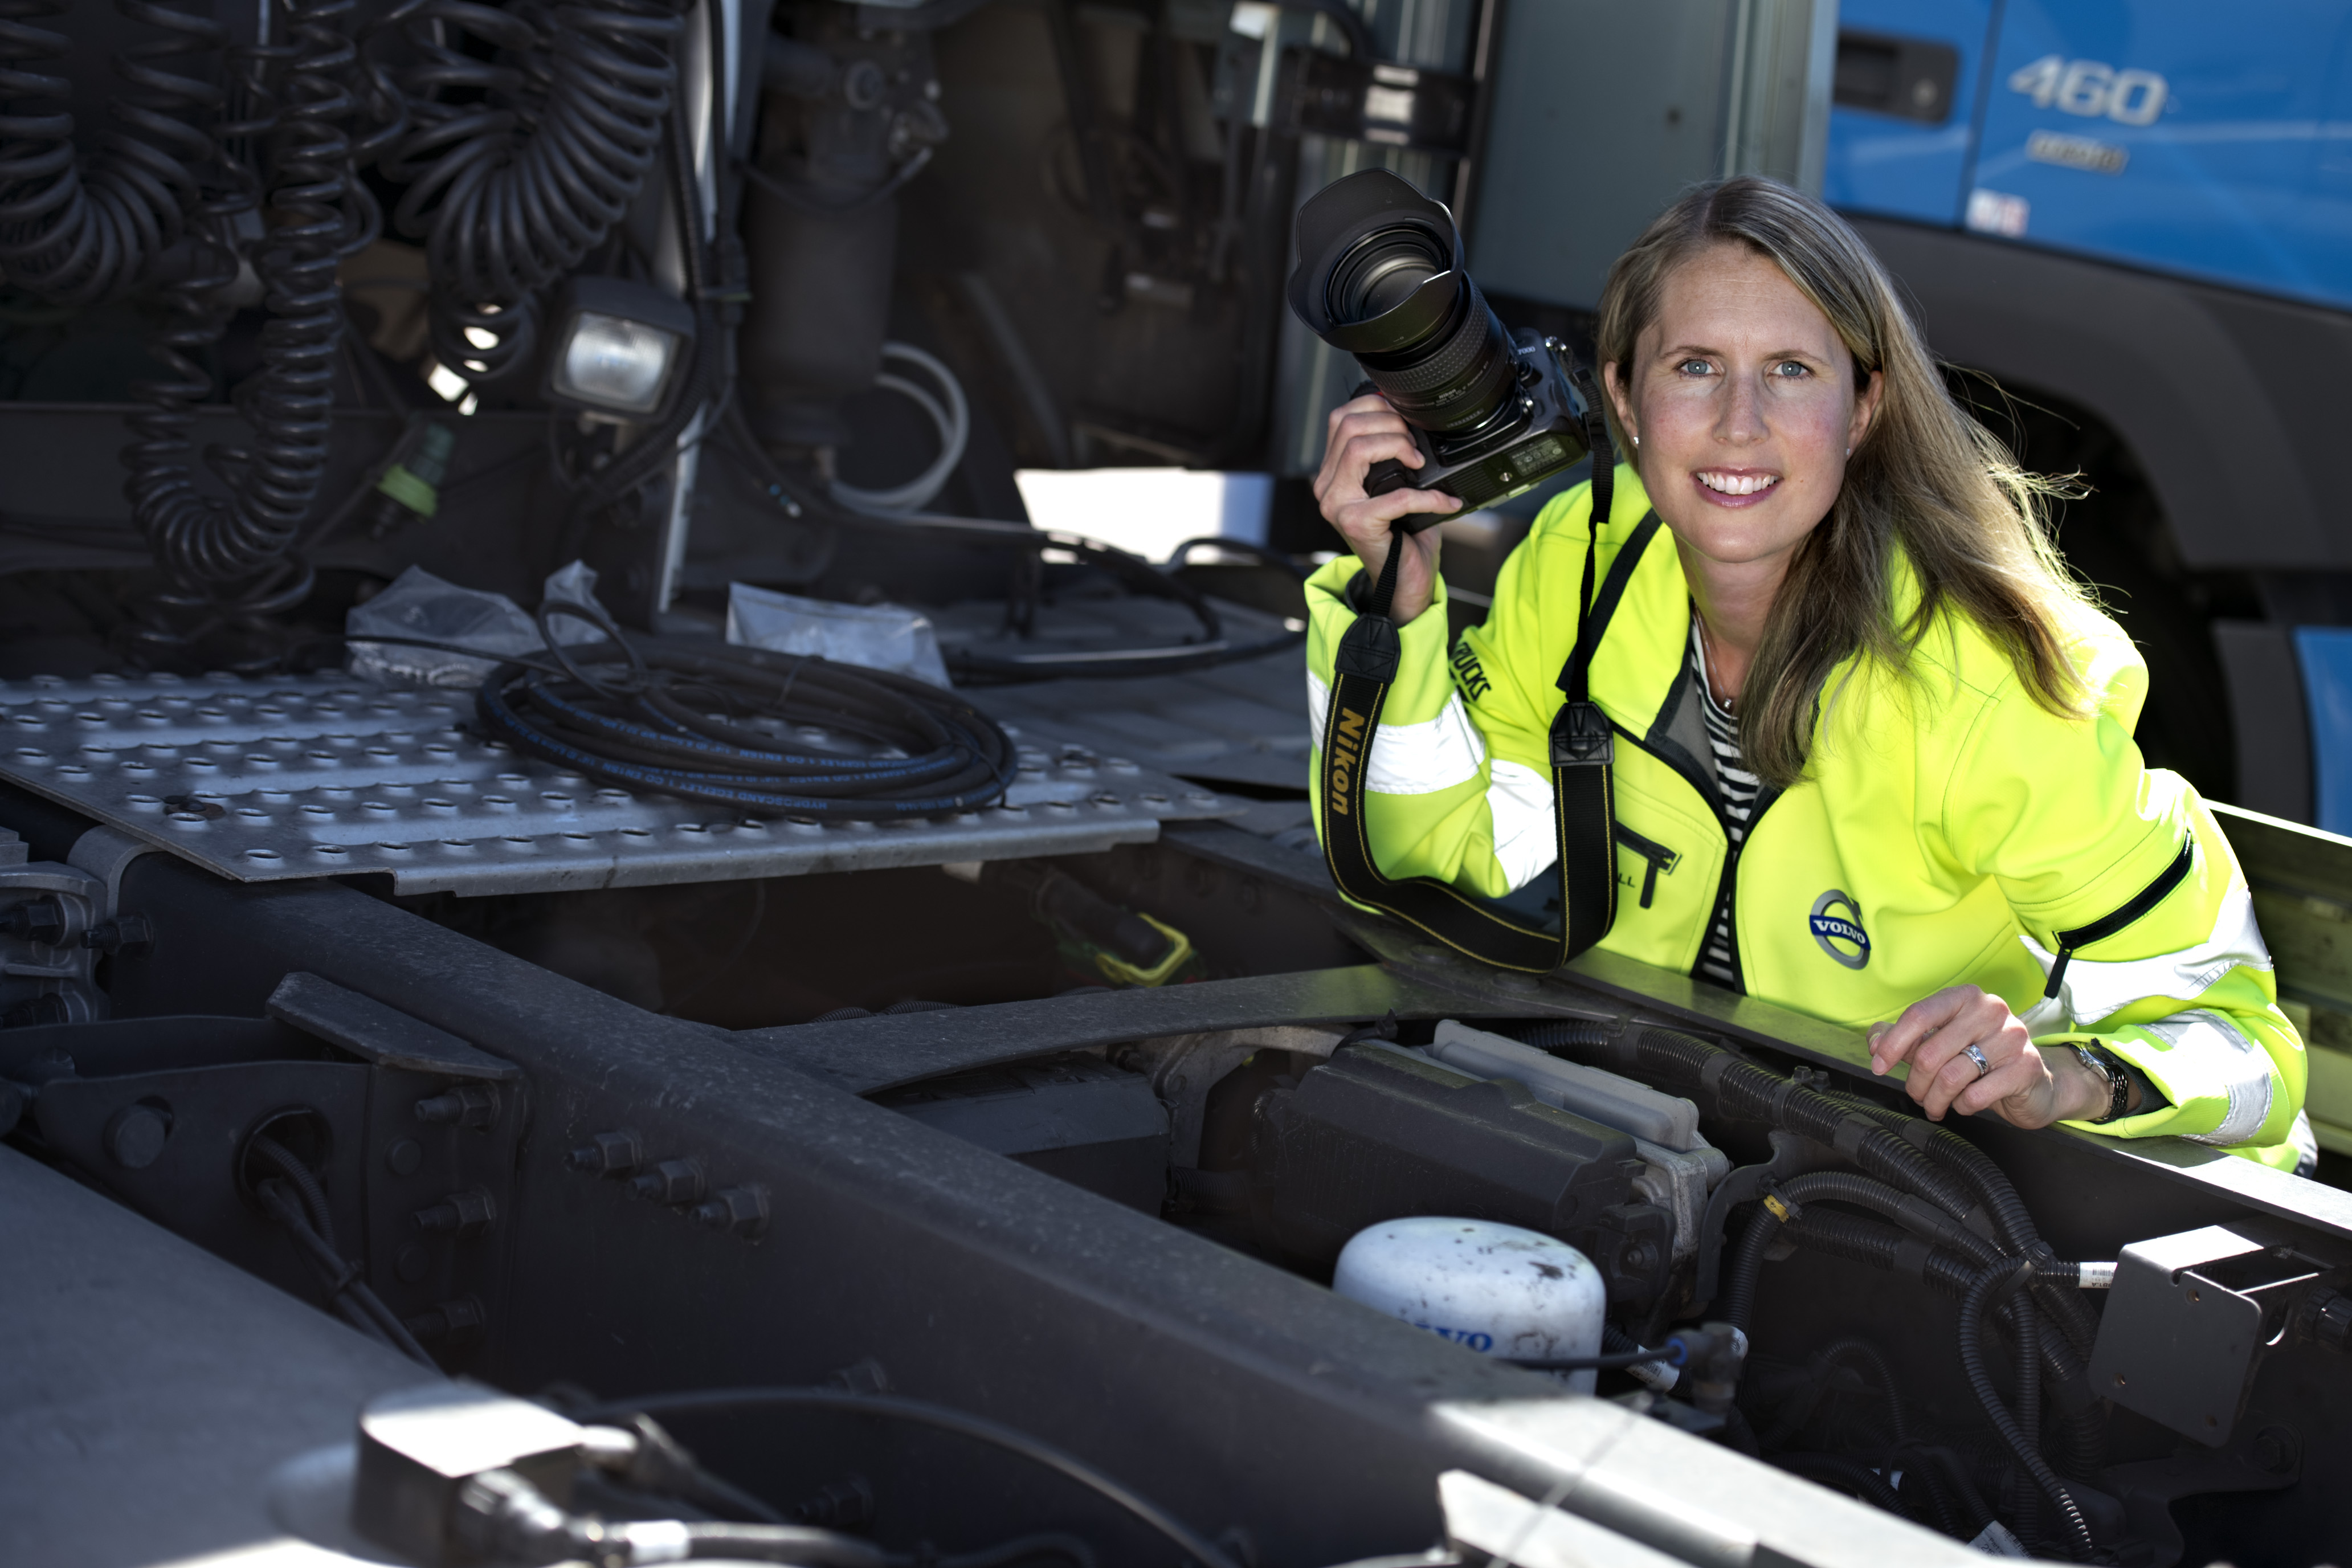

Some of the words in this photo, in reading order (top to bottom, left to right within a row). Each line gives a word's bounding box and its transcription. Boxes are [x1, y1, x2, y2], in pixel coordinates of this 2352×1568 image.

[2008, 55, 2169, 125] 460
[1439, 389, 1456, 399] Nikon
[1453, 642, 1492, 701] RUCKS
[1332, 707, 1365, 815] Nikon
[645, 774, 665, 786] CO
[679, 783, 734, 799] EGEFLEX
[738, 792, 828, 810] HYDROSCAND
[1813, 920, 1866, 944] VOLVO
